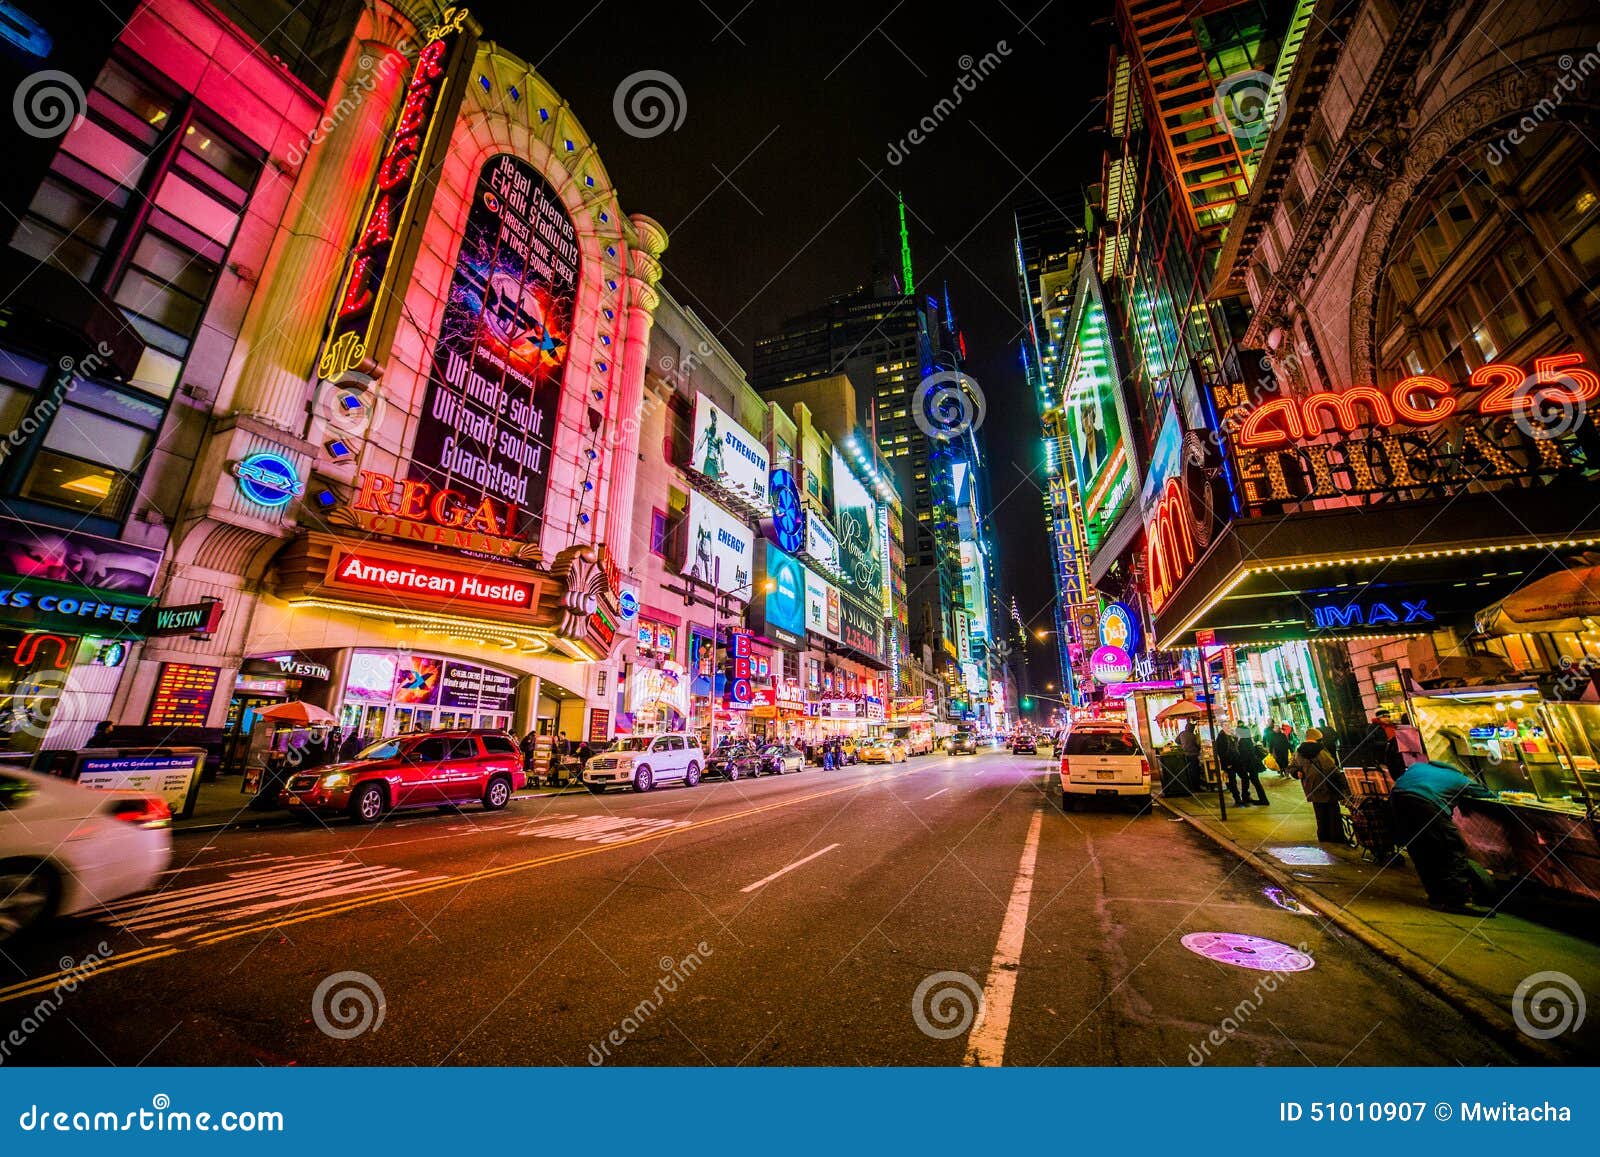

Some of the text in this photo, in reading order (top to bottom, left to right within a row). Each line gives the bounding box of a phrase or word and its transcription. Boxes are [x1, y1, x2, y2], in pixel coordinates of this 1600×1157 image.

[339, 38, 447, 318] REGAL
[491, 168, 526, 216] E-Walk
[500, 156, 574, 241] Regal Cinemas
[498, 204, 530, 242] LARGEST
[531, 235, 551, 263] MOVIE
[509, 233, 530, 260] TIMES
[529, 253, 554, 284] SQUARE
[445, 351, 543, 438] Ultimate sight.
[1238, 352, 1600, 446] amc 25
[432, 386, 542, 475] Ultimate sound.
[725, 432, 766, 472] STRENGTH
[236, 461, 304, 495] RPX
[441, 436, 529, 506] Guaranteed.
[354, 469, 529, 540] REGAL
[369, 516, 512, 559] CINEMAS
[717, 528, 745, 555] ENERGY
[342, 559, 456, 594] American
[460, 576, 526, 602] Hustle
[37, 595, 142, 624] COFFEE
[156, 609, 203, 629] WESTIN
[1314, 600, 1436, 627] IMAX
[960, 613, 968, 659] RICOH
[280, 660, 329, 679] WESTIN
[734, 635, 752, 703] BBQ
[1095, 663, 1128, 673] Hilton
[88, 762, 110, 770] Keep
[130, 760, 154, 768] Green
